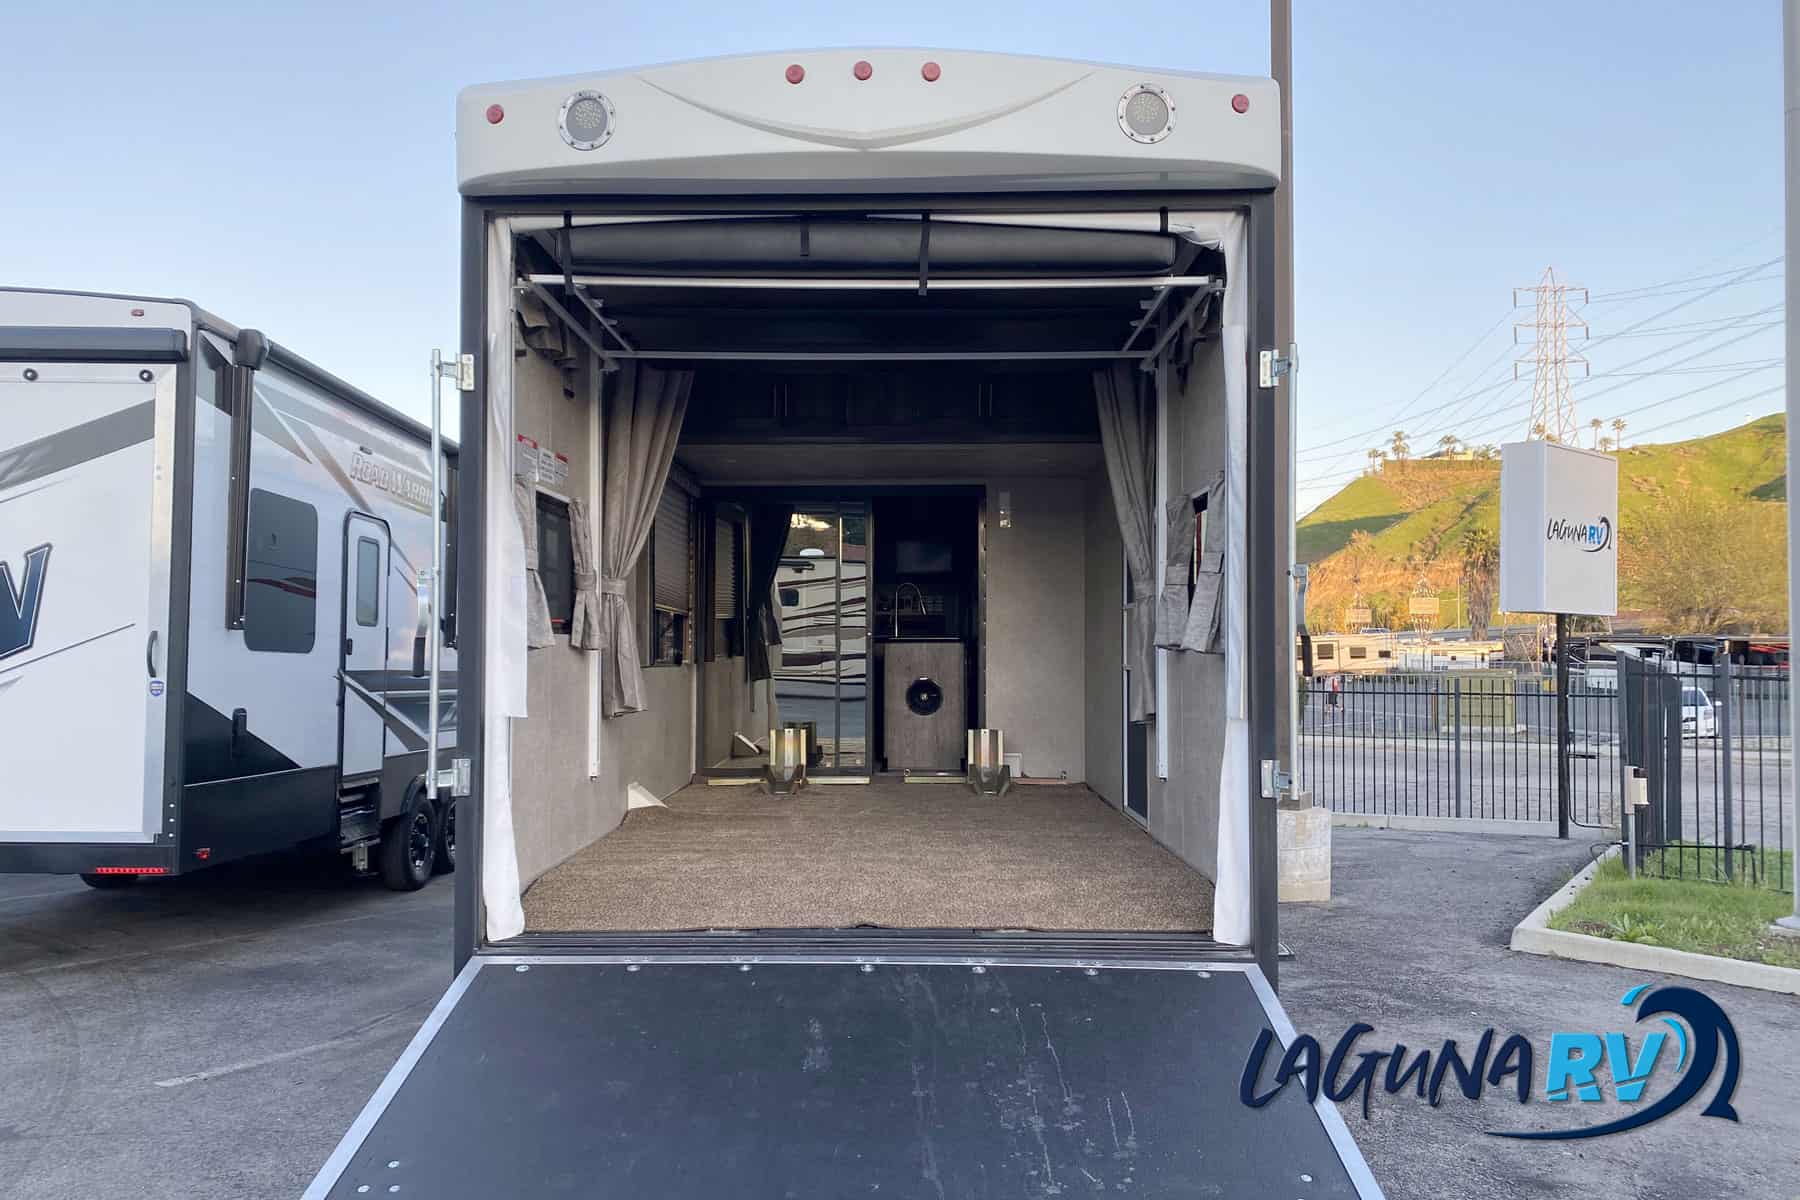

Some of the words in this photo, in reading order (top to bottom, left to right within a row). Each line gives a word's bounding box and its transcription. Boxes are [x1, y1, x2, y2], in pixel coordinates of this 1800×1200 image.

[350, 452, 388, 491] ROAD
[1547, 518, 1588, 544] LAGUNA
[1588, 525, 1604, 545] RV
